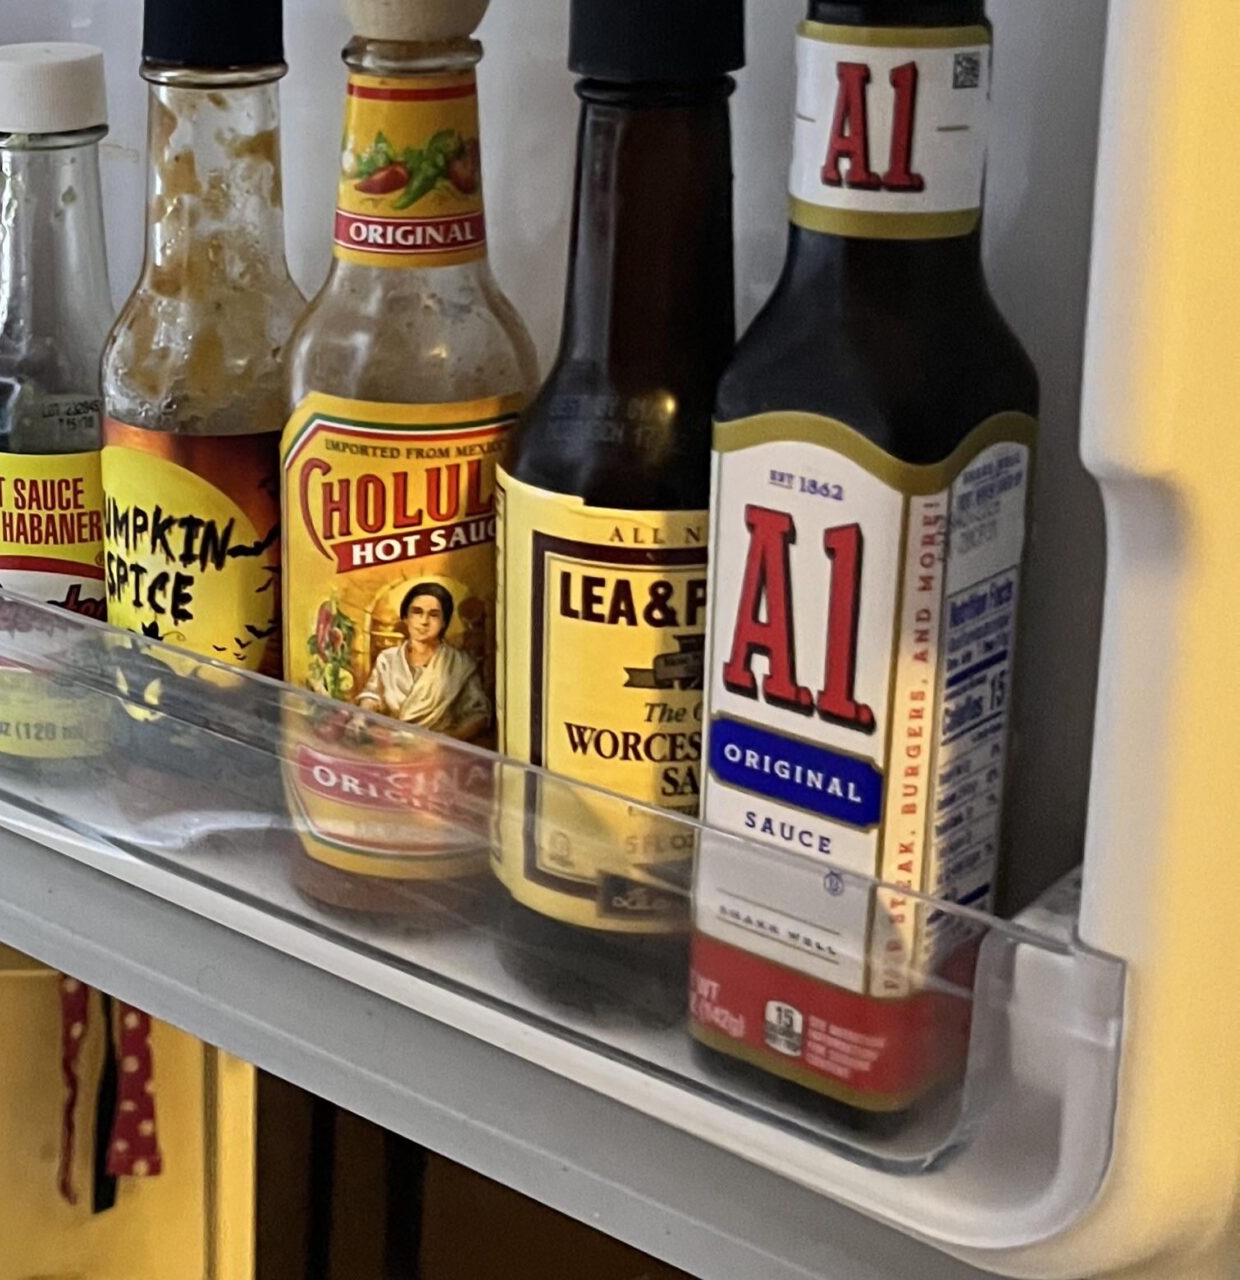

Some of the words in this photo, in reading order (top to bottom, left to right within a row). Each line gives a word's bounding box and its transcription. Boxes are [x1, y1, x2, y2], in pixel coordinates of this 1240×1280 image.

[349, 221, 476, 246] ORIGINAL
[325, 439, 401, 460] IMPORTED
[406, 446, 450, 460] FROM
[14, 477, 85, 511] SAUCE
[798, 476, 845, 502] 1862
[2, 509, 103, 546] HABANER
[609, 526, 665, 545] ALL
[352, 535, 421, 566] HOT
[106, 551, 195, 626] SPICE
[914, 608, 932, 664] AND
[644, 701, 686, 723] The
[564, 722, 701, 762] WORCES
[723, 743, 863, 804] ORIGINAL
[744, 810, 833, 855] SAUCE
[775, 1006, 794, 1029] 15
